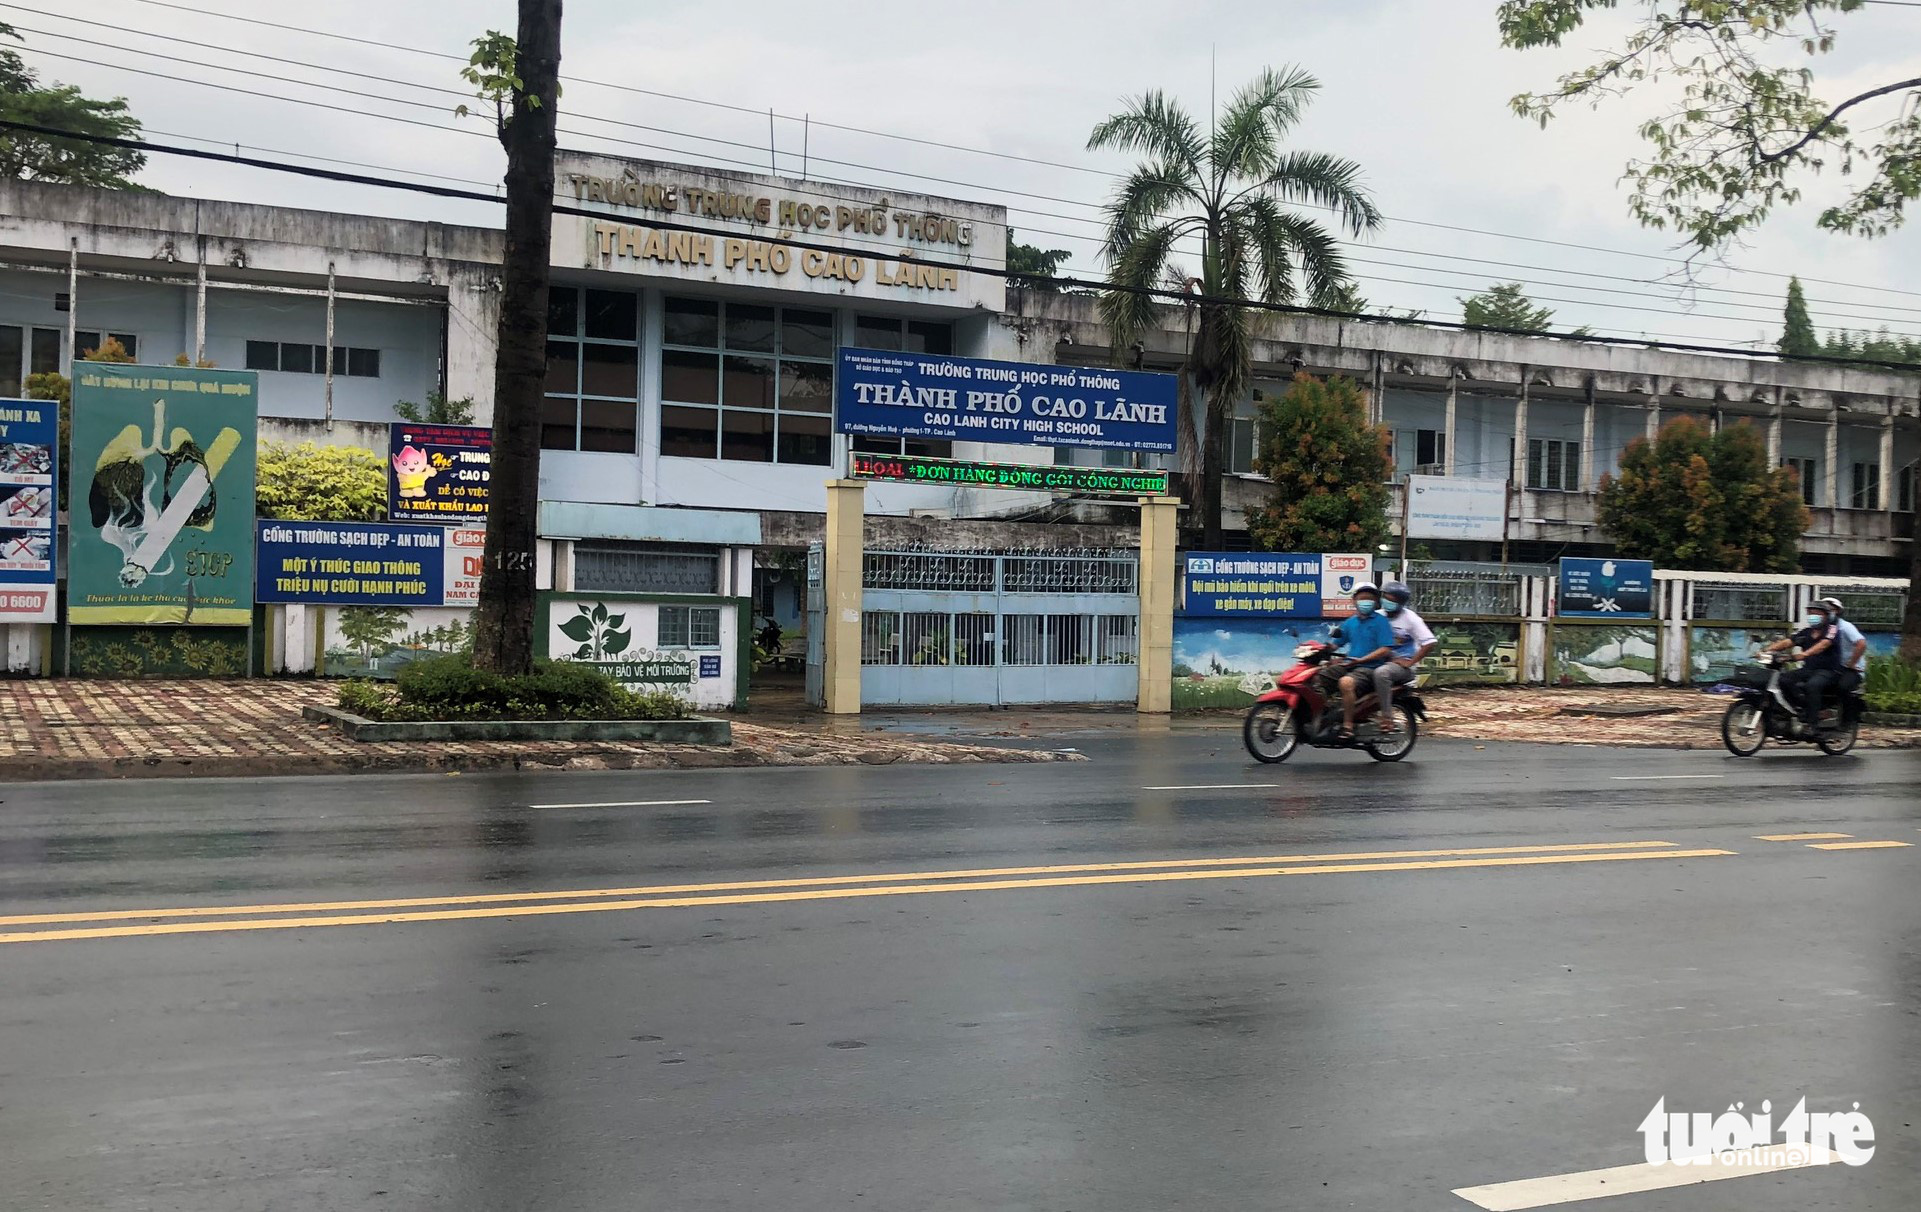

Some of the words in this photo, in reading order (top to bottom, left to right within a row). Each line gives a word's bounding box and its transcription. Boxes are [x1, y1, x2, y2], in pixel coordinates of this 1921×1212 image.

[571, 168, 678, 211] TRƯỜNG
[687, 187, 771, 224] TRUNG
[778, 199, 831, 233] HỌC
[836, 197, 889, 236] PHỔ
[893, 211, 972, 246] THÔNG
[802, 249, 865, 282] CAO
[876, 248, 958, 291] LÃNH
[918, 361, 971, 379] TRƯỜNG
[975, 367, 1018, 383] TRUNG
[1021, 371, 1048, 387] HỌC
[1051, 369, 1076, 387] PHỔ
[1079, 374, 1120, 390] THÔNG
[853, 380, 957, 410] THÀNH
[966, 383, 1022, 414] PHỐ
[1031, 396, 1087, 419] CAO
[1094, 397, 1167, 424] LÃNH
[26, 410, 41, 423] XA
[924, 412, 951, 426] CAO
[954, 414, 987, 428] LANH
[991, 417, 1020, 430] CITY
[1023, 419, 1053, 432] HIGH
[1056, 422, 1104, 436] SCHOOL
[459, 451, 491, 463] TRUNG
[459, 470, 480, 481] CAO
[953, 466, 996, 482] HÀNG
[1076, 472, 1119, 488] CÔNG
[453, 486, 465, 496] CÓ
[468, 486, 489, 498] VIỆC
[398, 499, 410, 509] VÀ
[412, 498, 437, 510] XUẤT
[439, 499, 464, 511] KHẨU
[465, 503, 483, 512] LAO
[412, 513, 488, 521] xuatkhaulaodongdongth
[263, 525, 293, 543] CỔNG
[295, 528, 338, 545] TRƯỜNG
[340, 532, 368, 547] SẠCH
[370, 532, 389, 549] ĐẸP
[397, 534, 411, 547] AN
[413, 532, 440, 548] TOÀN
[185, 550, 233, 578] STOP
[282, 557, 308, 574] MỘT
[310, 557, 317, 573] Ý
[320, 557, 351, 574] THỨC
[353, 561, 380, 575] GIAO
[383, 560, 421, 575] THÔNG
[1215, 558, 1233, 574] CỔNG
[1234, 560, 1259, 574] TRƯỜNG
[1260, 561, 1276, 577] SẠCH
[1277, 561, 1289, 577] ĐẸP
[1293, 562, 1302, 574] AN
[1303, 560, 1319, 575] TOÀN
[276, 577, 310, 595] TRIỆU
[312, 579, 328, 595] NỤ
[331, 577, 359, 593] CƯỜI
[362, 581, 393, 596] HẠNH
[395, 577, 426, 594] PHÚC
[455, 581, 474, 590] ĐẠI
[1192, 579, 1204, 595] Đội
[1216, 578, 1229, 592] bảo
[1247, 580, 1258, 592] khi
[1289, 583, 1298, 593] xe
[10, 595, 41, 608] 6600
[446, 591, 467, 599] NAM
[1215, 599, 1223, 609] xe
[1254, 599, 1262, 609] xe
[616, 664, 632, 678] BẢO
[635, 664, 644, 679] VỆ
[646, 664, 659, 676] MÔI
[661, 663, 689, 676] TRƯỜNG
